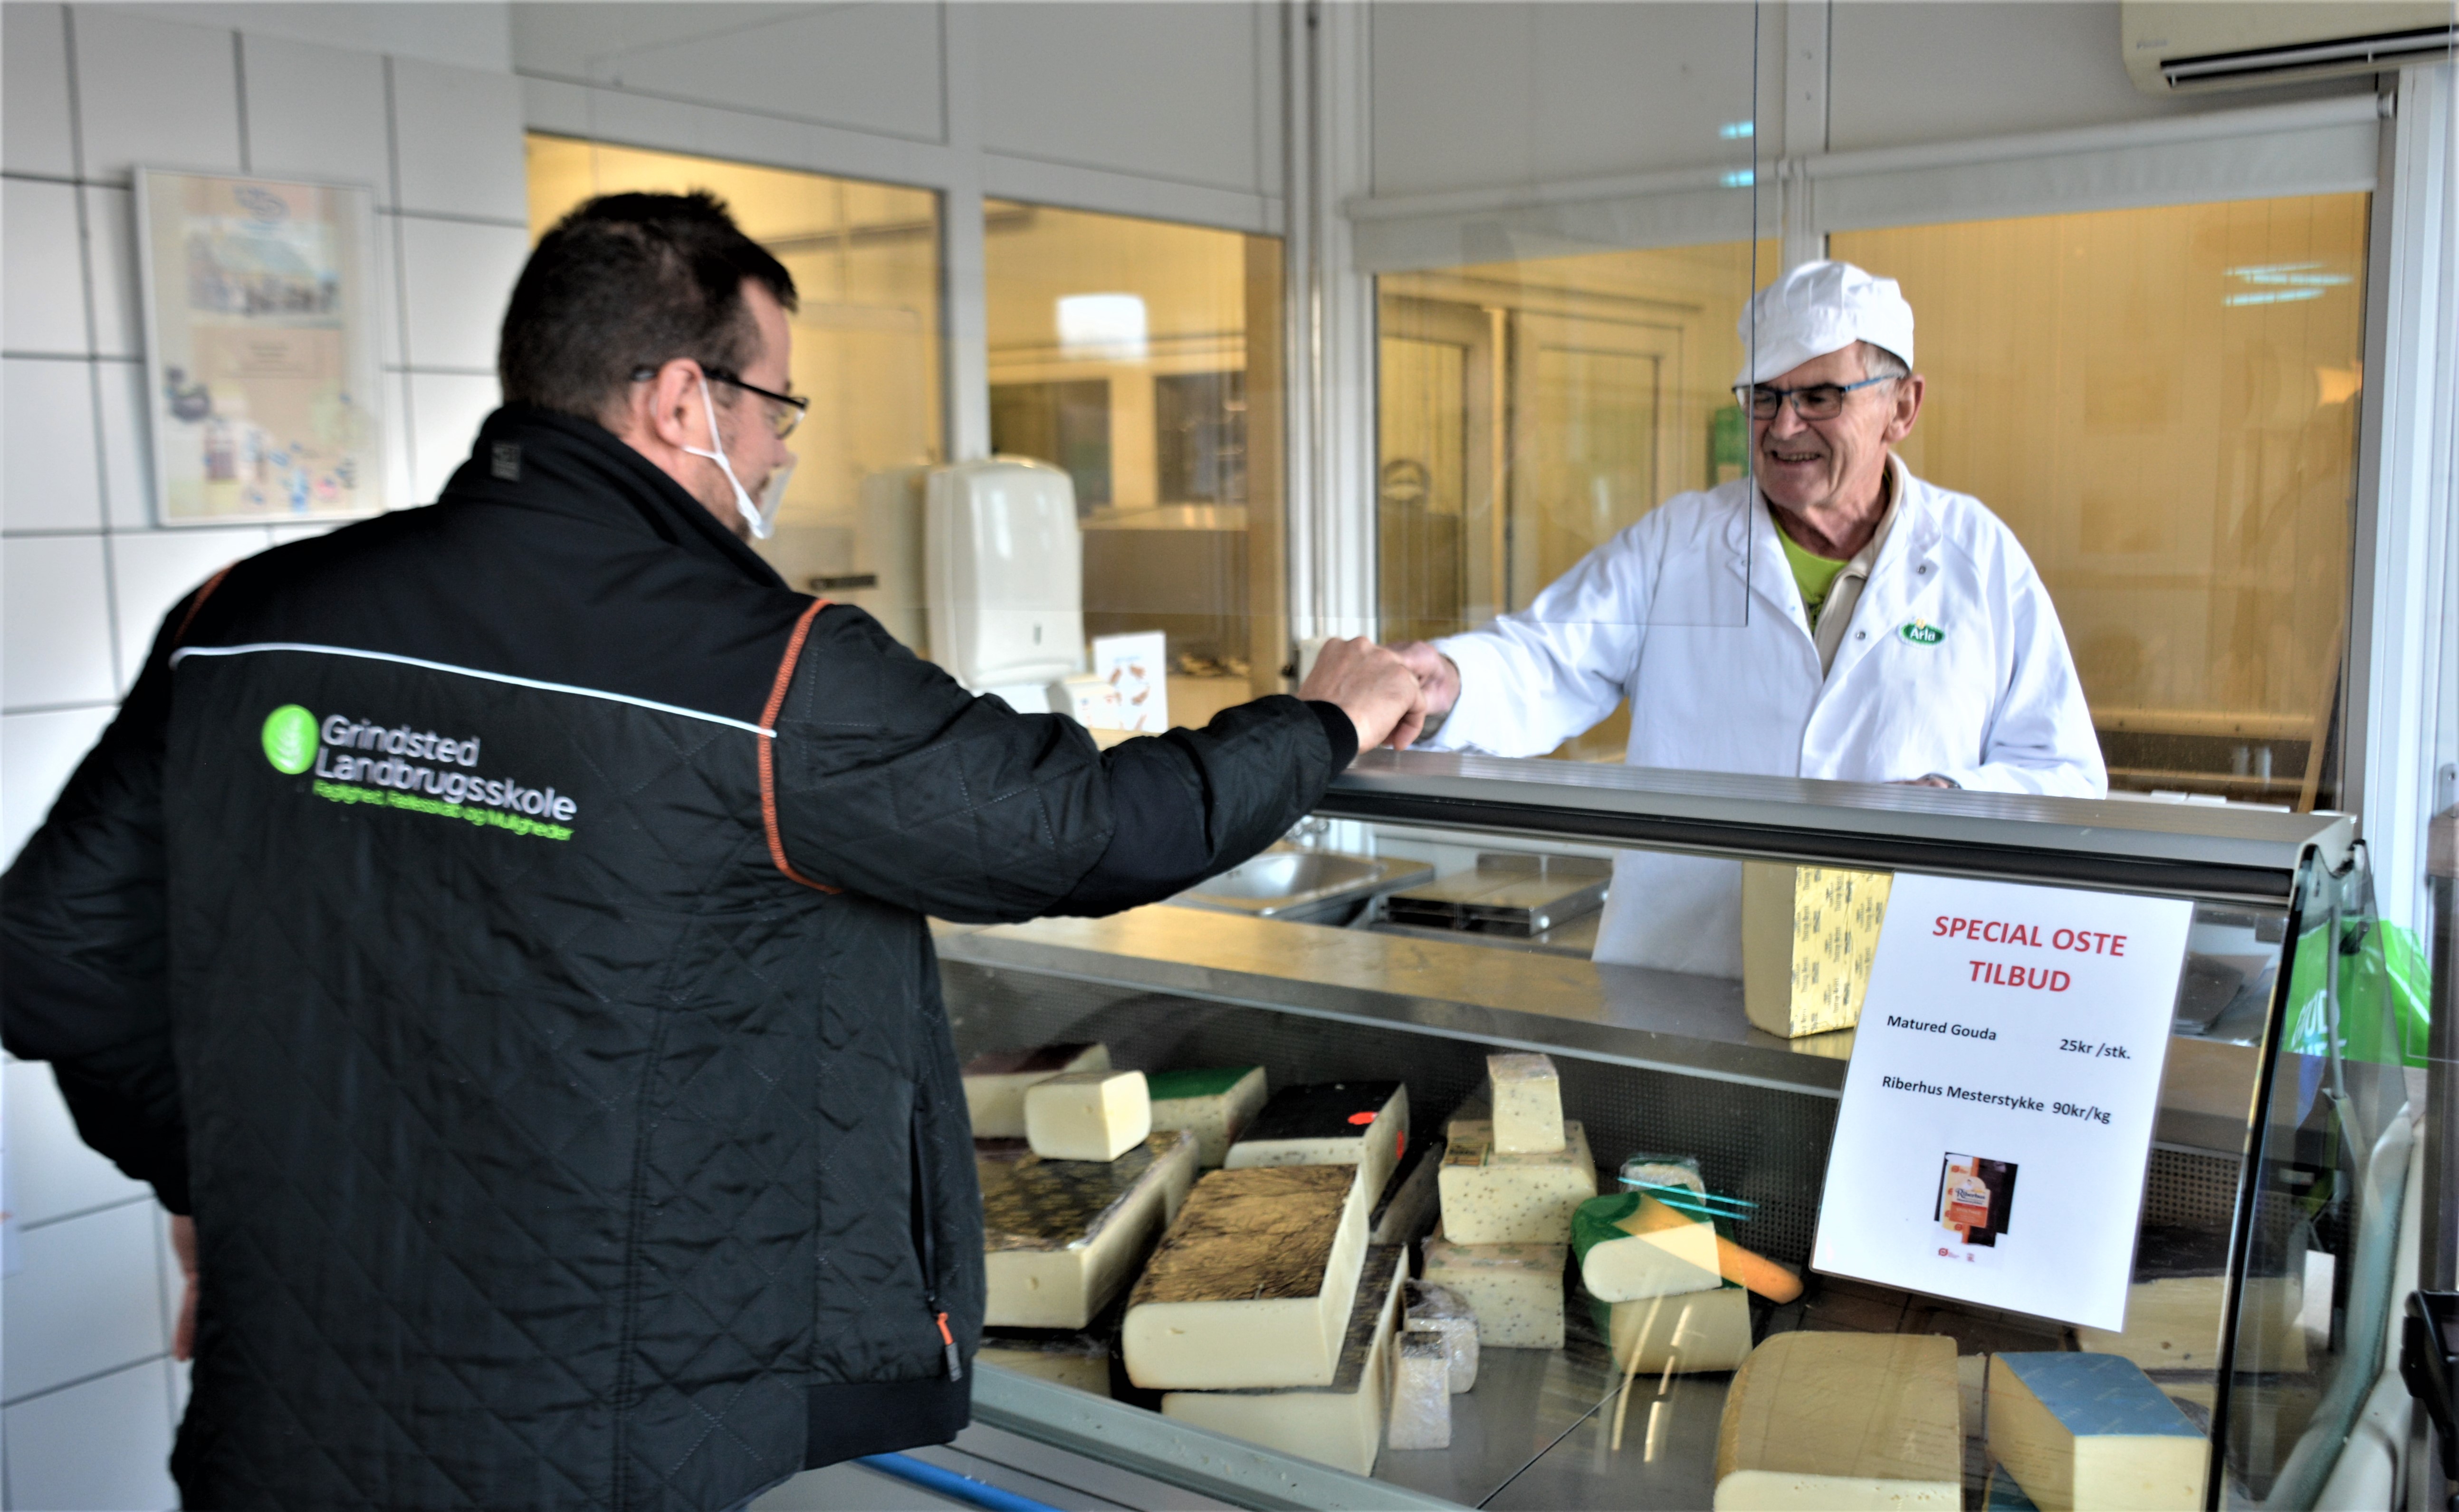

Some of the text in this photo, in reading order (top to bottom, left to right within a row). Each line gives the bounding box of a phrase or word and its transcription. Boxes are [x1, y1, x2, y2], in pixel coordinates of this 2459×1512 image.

[1910, 627, 1936, 641] Arla
[321, 714, 480, 768] Grindsted
[314, 745, 577, 821] Landbrugsskole
[1933, 916, 2127, 957] SPECIAL OSTE
[1969, 960, 2071, 993] TILBUD
[1886, 1014, 2132, 1059] Matured Gouda 25kr /stk.
[1882, 1075, 2111, 1125] Riberhus Mesterstykke 90kr/kg
